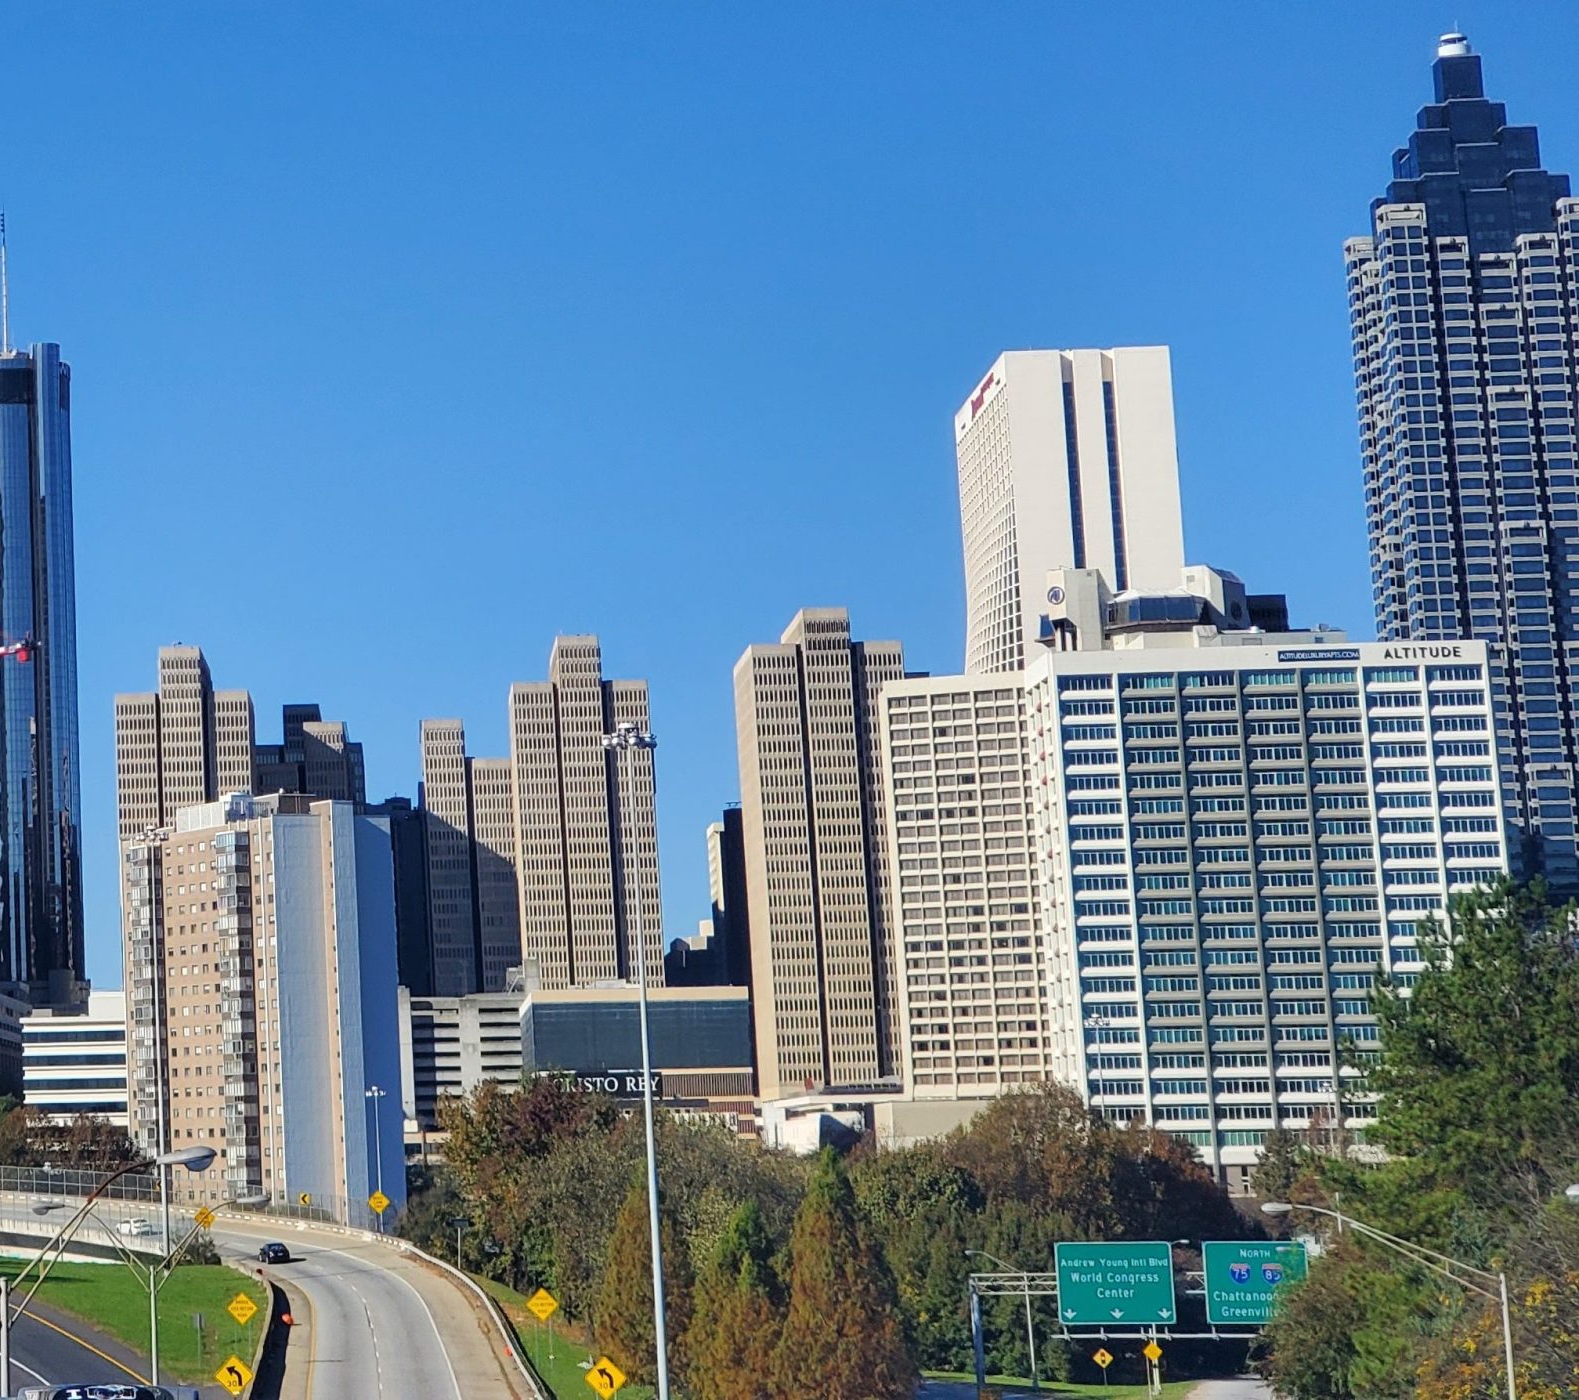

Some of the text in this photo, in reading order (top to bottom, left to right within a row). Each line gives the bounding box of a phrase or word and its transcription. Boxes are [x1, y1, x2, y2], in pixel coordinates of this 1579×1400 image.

[1383, 646, 1462, 659] ALTITUDE
[1239, 1248, 1271, 1258] NORTH
[1061, 1258, 1095, 1267] Andrew
[1100, 1258, 1129, 1269] Young
[1148, 1257, 1169, 1267] Blvd
[1070, 1272, 1159, 1285] World Congress
[1233, 1269, 1281, 1280] 75 85
[1096, 1287, 1135, 1298] Center
